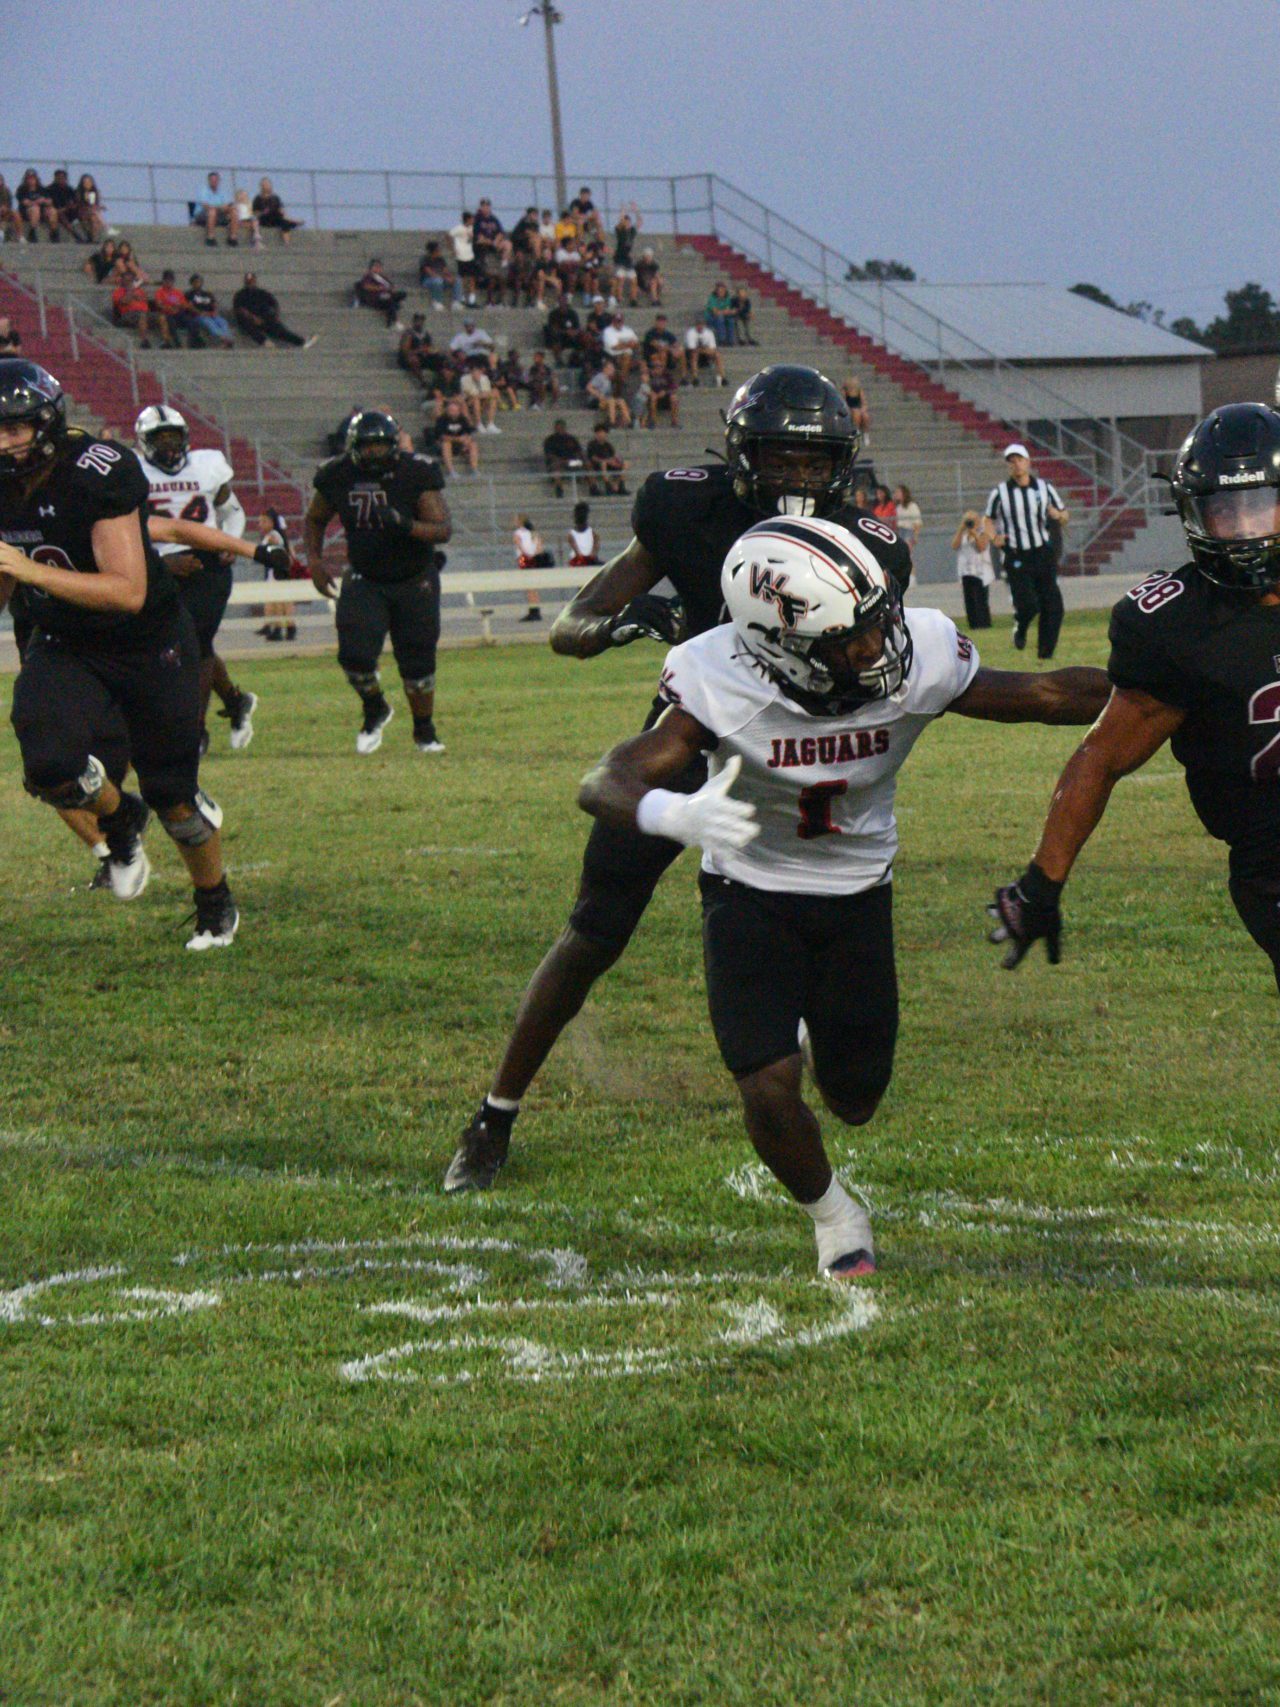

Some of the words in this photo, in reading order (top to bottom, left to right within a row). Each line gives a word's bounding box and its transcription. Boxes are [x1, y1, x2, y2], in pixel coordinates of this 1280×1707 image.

[77, 444, 121, 476] 70
[664, 468, 709, 481] 8
[1219, 471, 1265, 485] Riddell
[858, 518, 897, 544] 8
[1126, 572, 1185, 613] 28
[767, 729, 890, 768] JAGUARS
